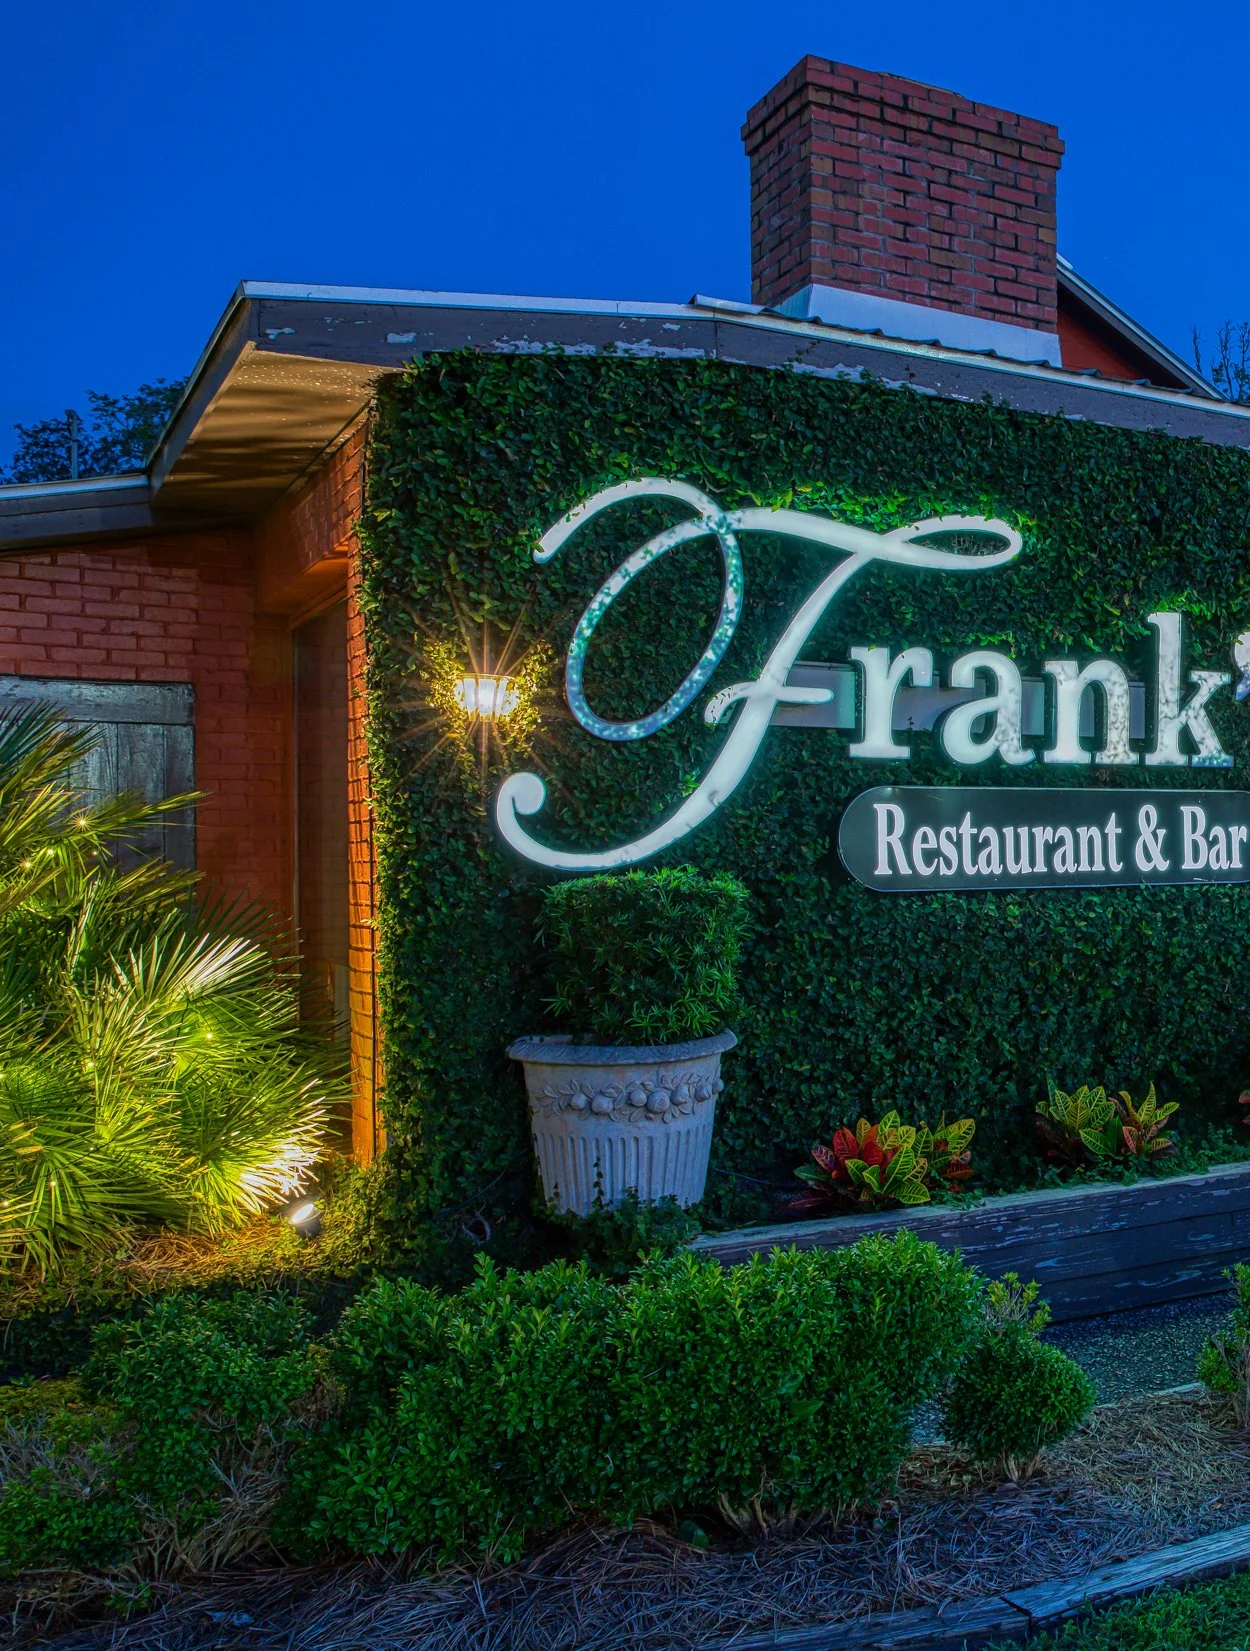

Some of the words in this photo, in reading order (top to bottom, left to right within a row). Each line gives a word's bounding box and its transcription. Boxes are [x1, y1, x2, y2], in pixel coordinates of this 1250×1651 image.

[873, 801, 1125, 878] Restaurant
[1134, 803, 1171, 873] &
[1180, 804, 1248, 872] Bar
